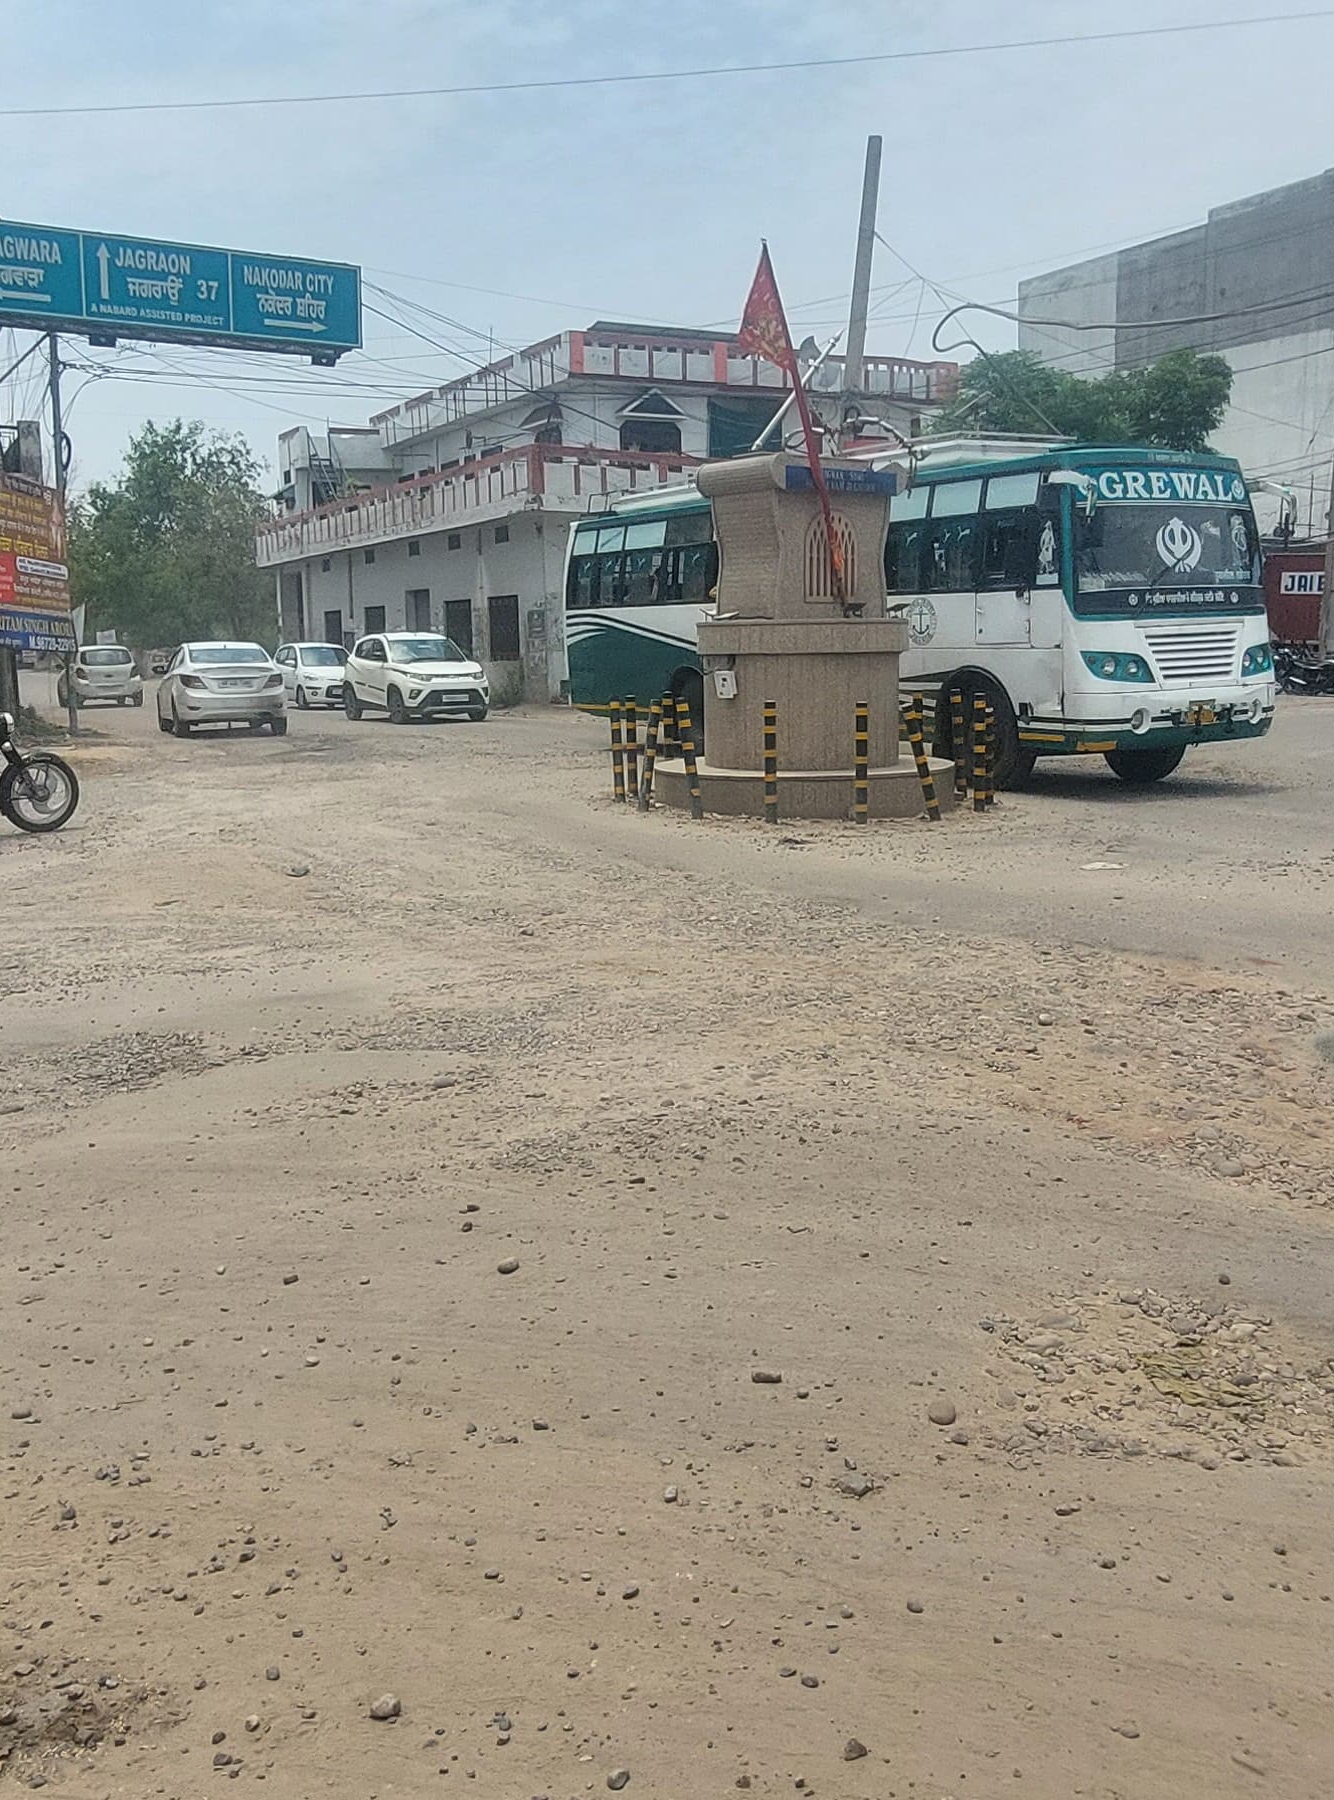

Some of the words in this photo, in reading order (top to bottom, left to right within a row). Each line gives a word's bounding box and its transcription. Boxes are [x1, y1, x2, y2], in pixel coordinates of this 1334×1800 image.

[115, 247, 190, 275] JAGRAON
[126, 275, 183, 305] ਜਗਰਾਉਂ
[197, 279, 219, 301] 37
[243, 265, 303, 291] NAKODAR
[306, 273, 334, 296] CITY
[91, 303, 98, 313] A
[100, 304, 138, 317] NABARD
[139, 308, 183, 322] ASSISTED
[184, 313, 224, 326] PROJECT
[256, 289, 293, 315] ਨਕੋਦਰ
[1098, 471, 1233, 501] GREWAL
[1284, 575, 1313, 592] JAI
[24, 618, 49, 635] SINGH
